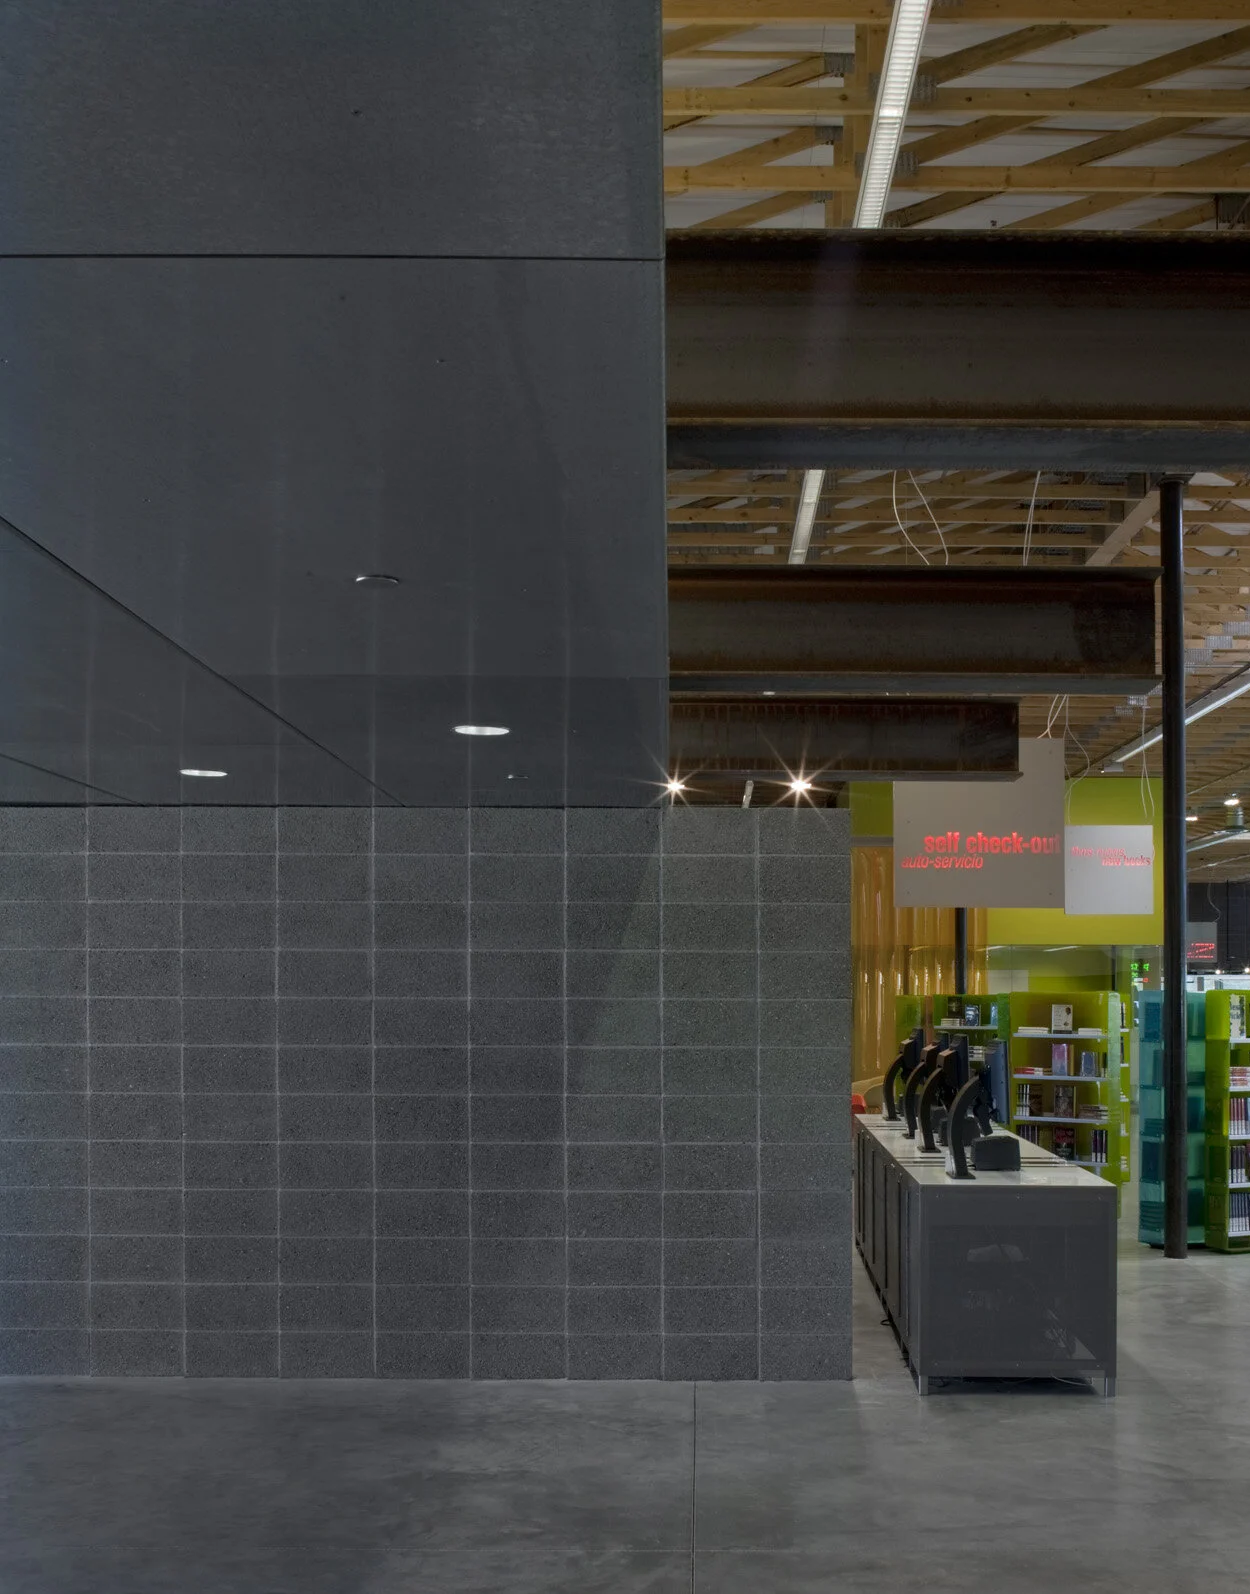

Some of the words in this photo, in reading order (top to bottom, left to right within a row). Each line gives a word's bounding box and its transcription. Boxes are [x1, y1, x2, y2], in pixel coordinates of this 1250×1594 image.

[923, 831, 960, 854] self
[965, 831, 1062, 854] check-out
[901, 853, 984, 869] auto-servicio
